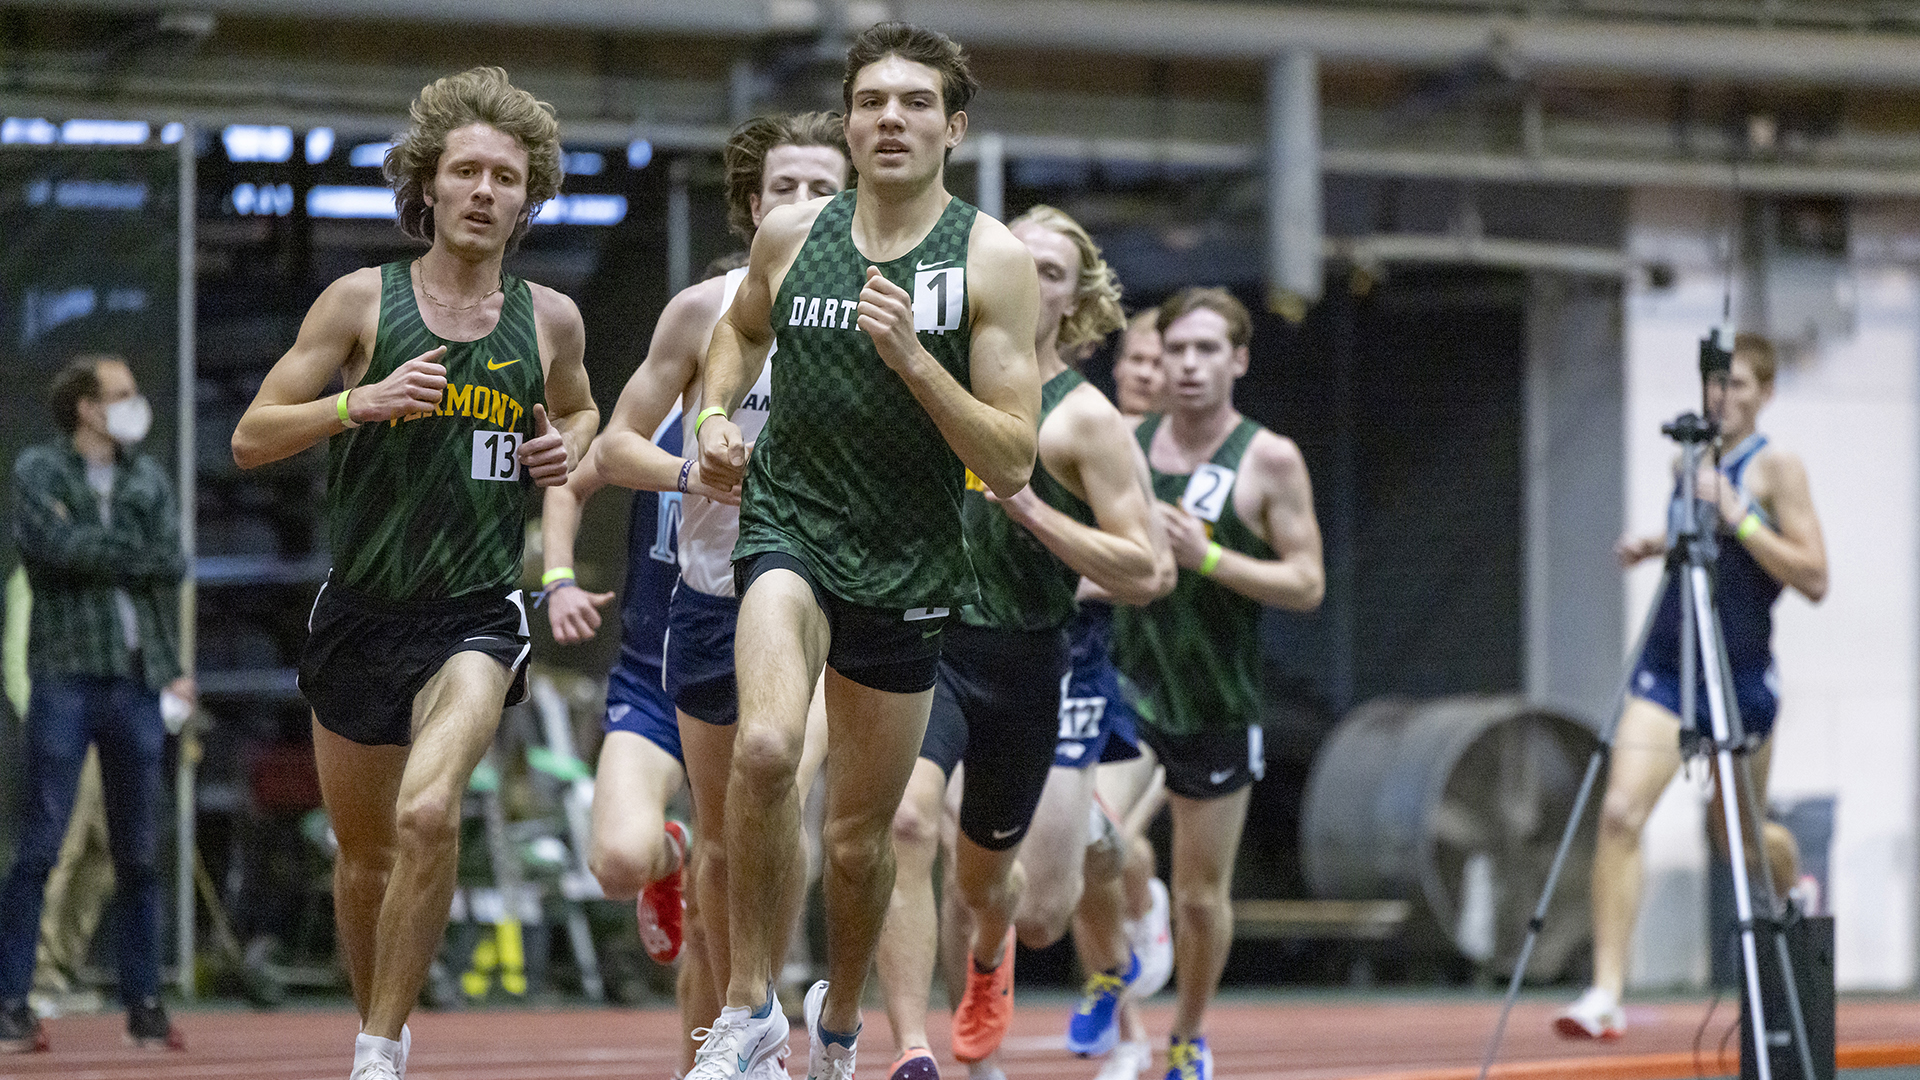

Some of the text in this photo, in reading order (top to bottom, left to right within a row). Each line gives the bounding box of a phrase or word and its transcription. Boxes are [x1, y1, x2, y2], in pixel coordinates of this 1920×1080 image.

[926, 271, 947, 327] 1
[390, 383, 524, 433] MONT
[484, 433, 517, 479] 13
[1193, 470, 1221, 511] 2
